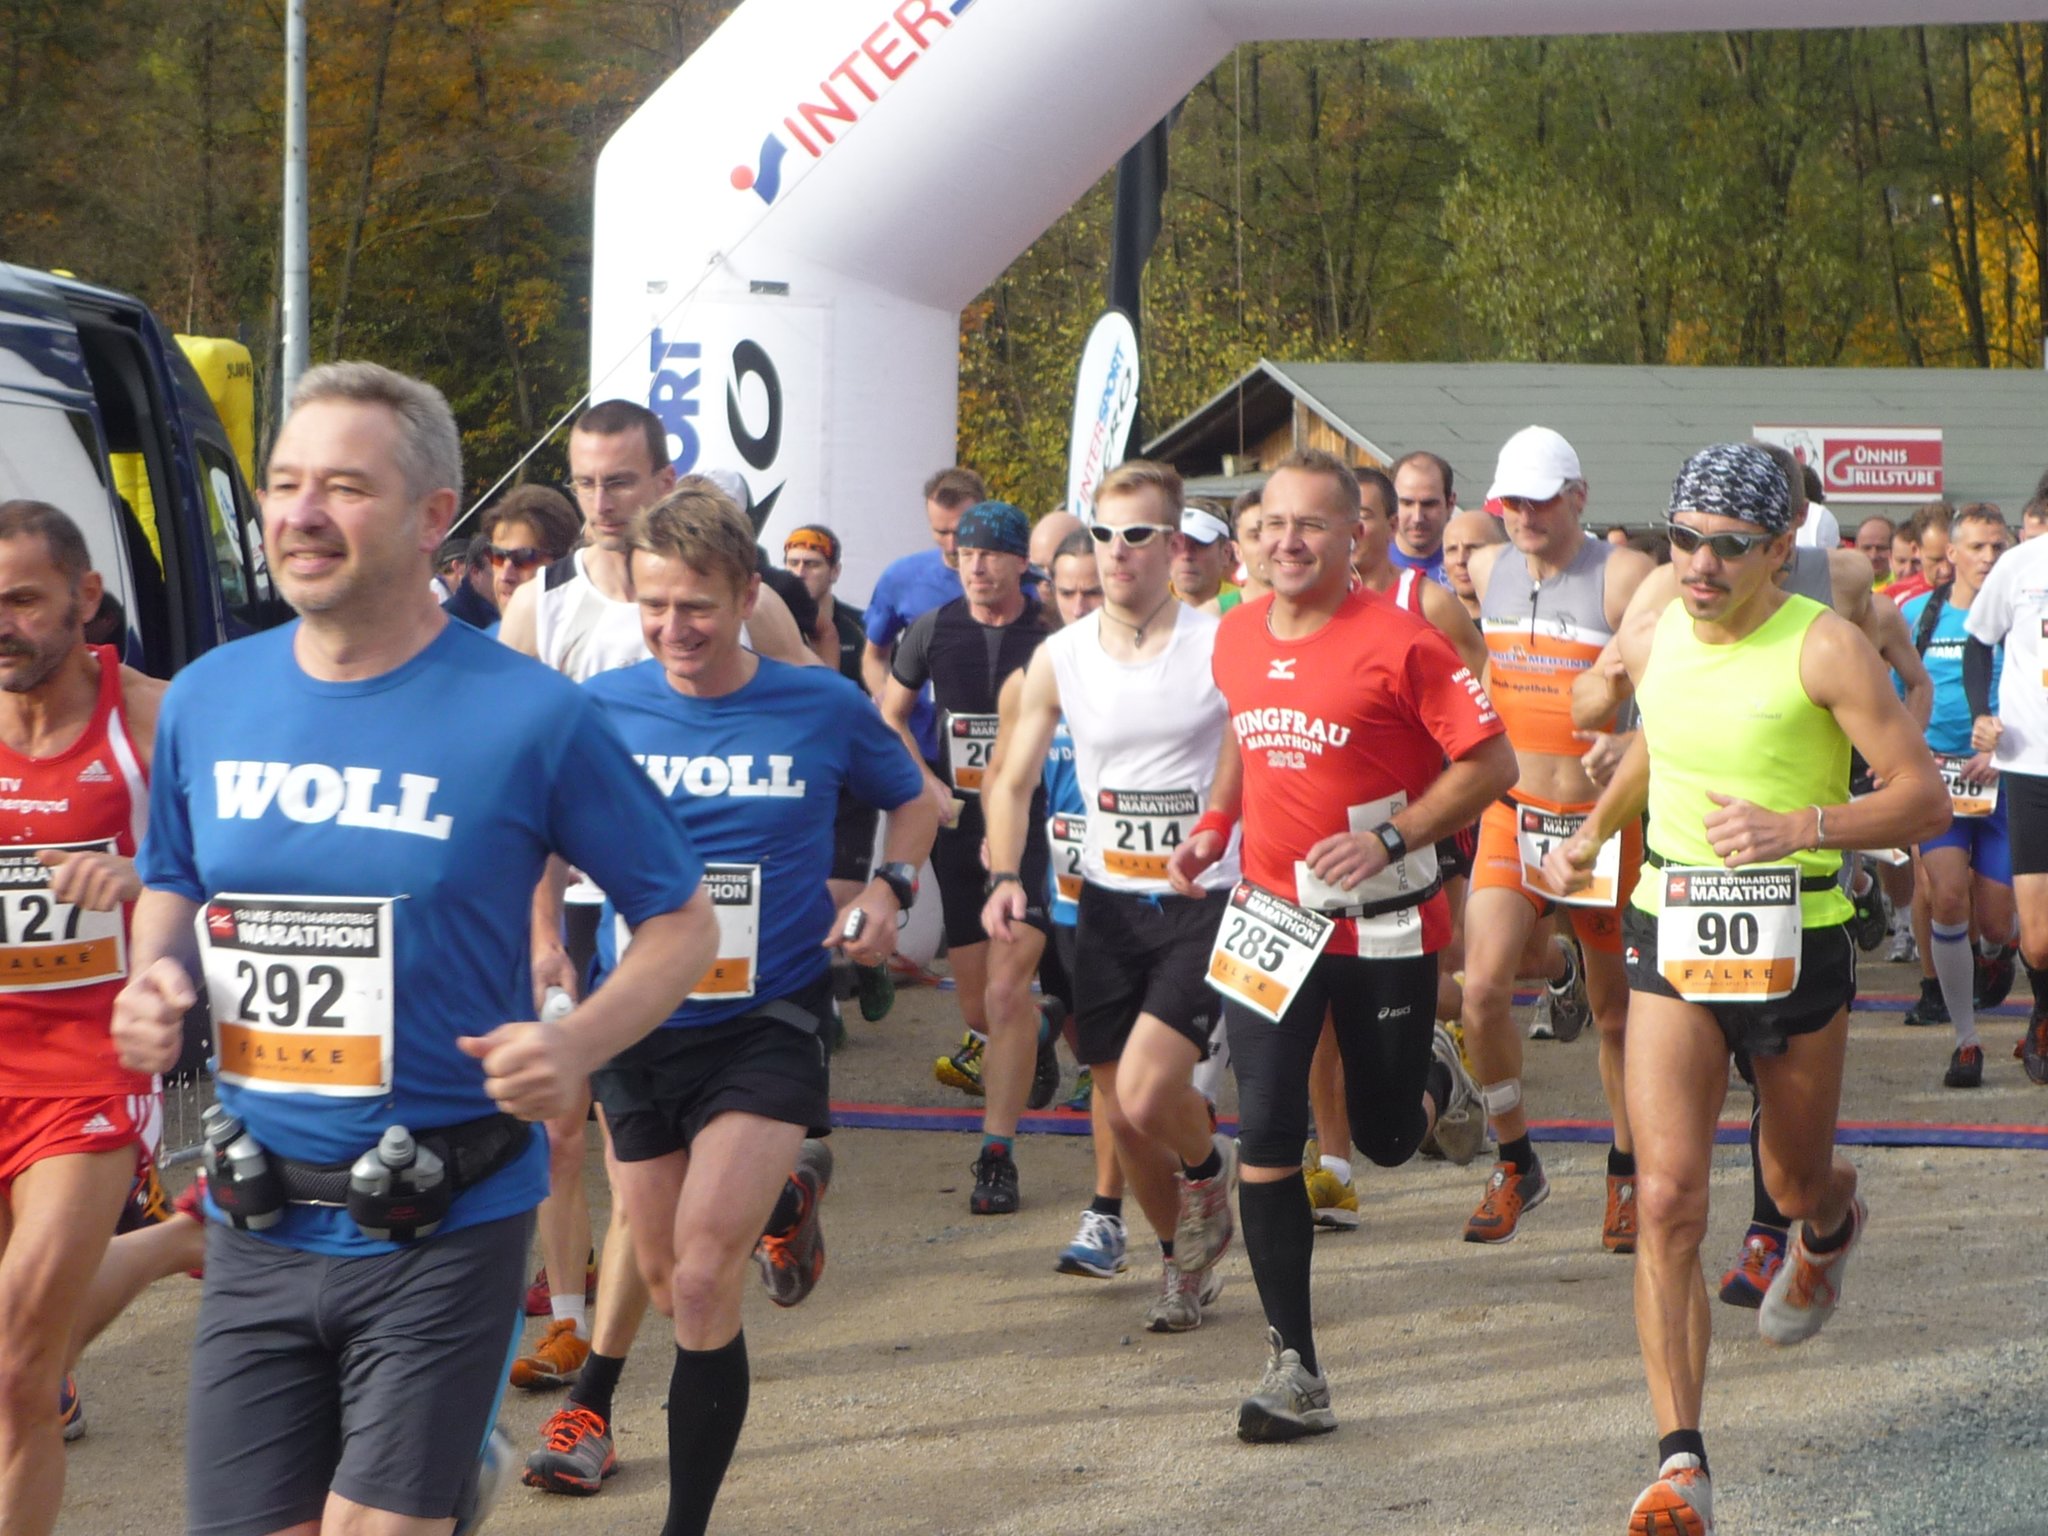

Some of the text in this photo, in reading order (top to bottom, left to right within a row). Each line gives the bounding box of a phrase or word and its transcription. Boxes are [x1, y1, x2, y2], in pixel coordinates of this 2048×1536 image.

[783, 0, 974, 158] INTER
[1079, 337, 1124, 505] INTERSPORT
[1232, 707, 1351, 747] JUNGFRAU
[1247, 733, 1323, 755] MARATHON
[1267, 751, 1307, 769] 2012
[213, 760, 454, 841] WOLL
[1119, 801, 1195, 814] MARATHON
[1115, 820, 1184, 852] 214
[1690, 884, 1791, 901] MARATHON
[1691, 875, 1791, 886] FALKE ROTHAARSTEIG
[237, 922, 375, 949] MARATHON
[1244, 895, 1319, 945] MARATHON
[1697, 911, 1759, 955] 90
[1224, 916, 1291, 973] 285
[1684, 968, 1774, 980] FALKE
[236, 959, 345, 1029] 292
[240, 1041, 344, 1064] FALKE
